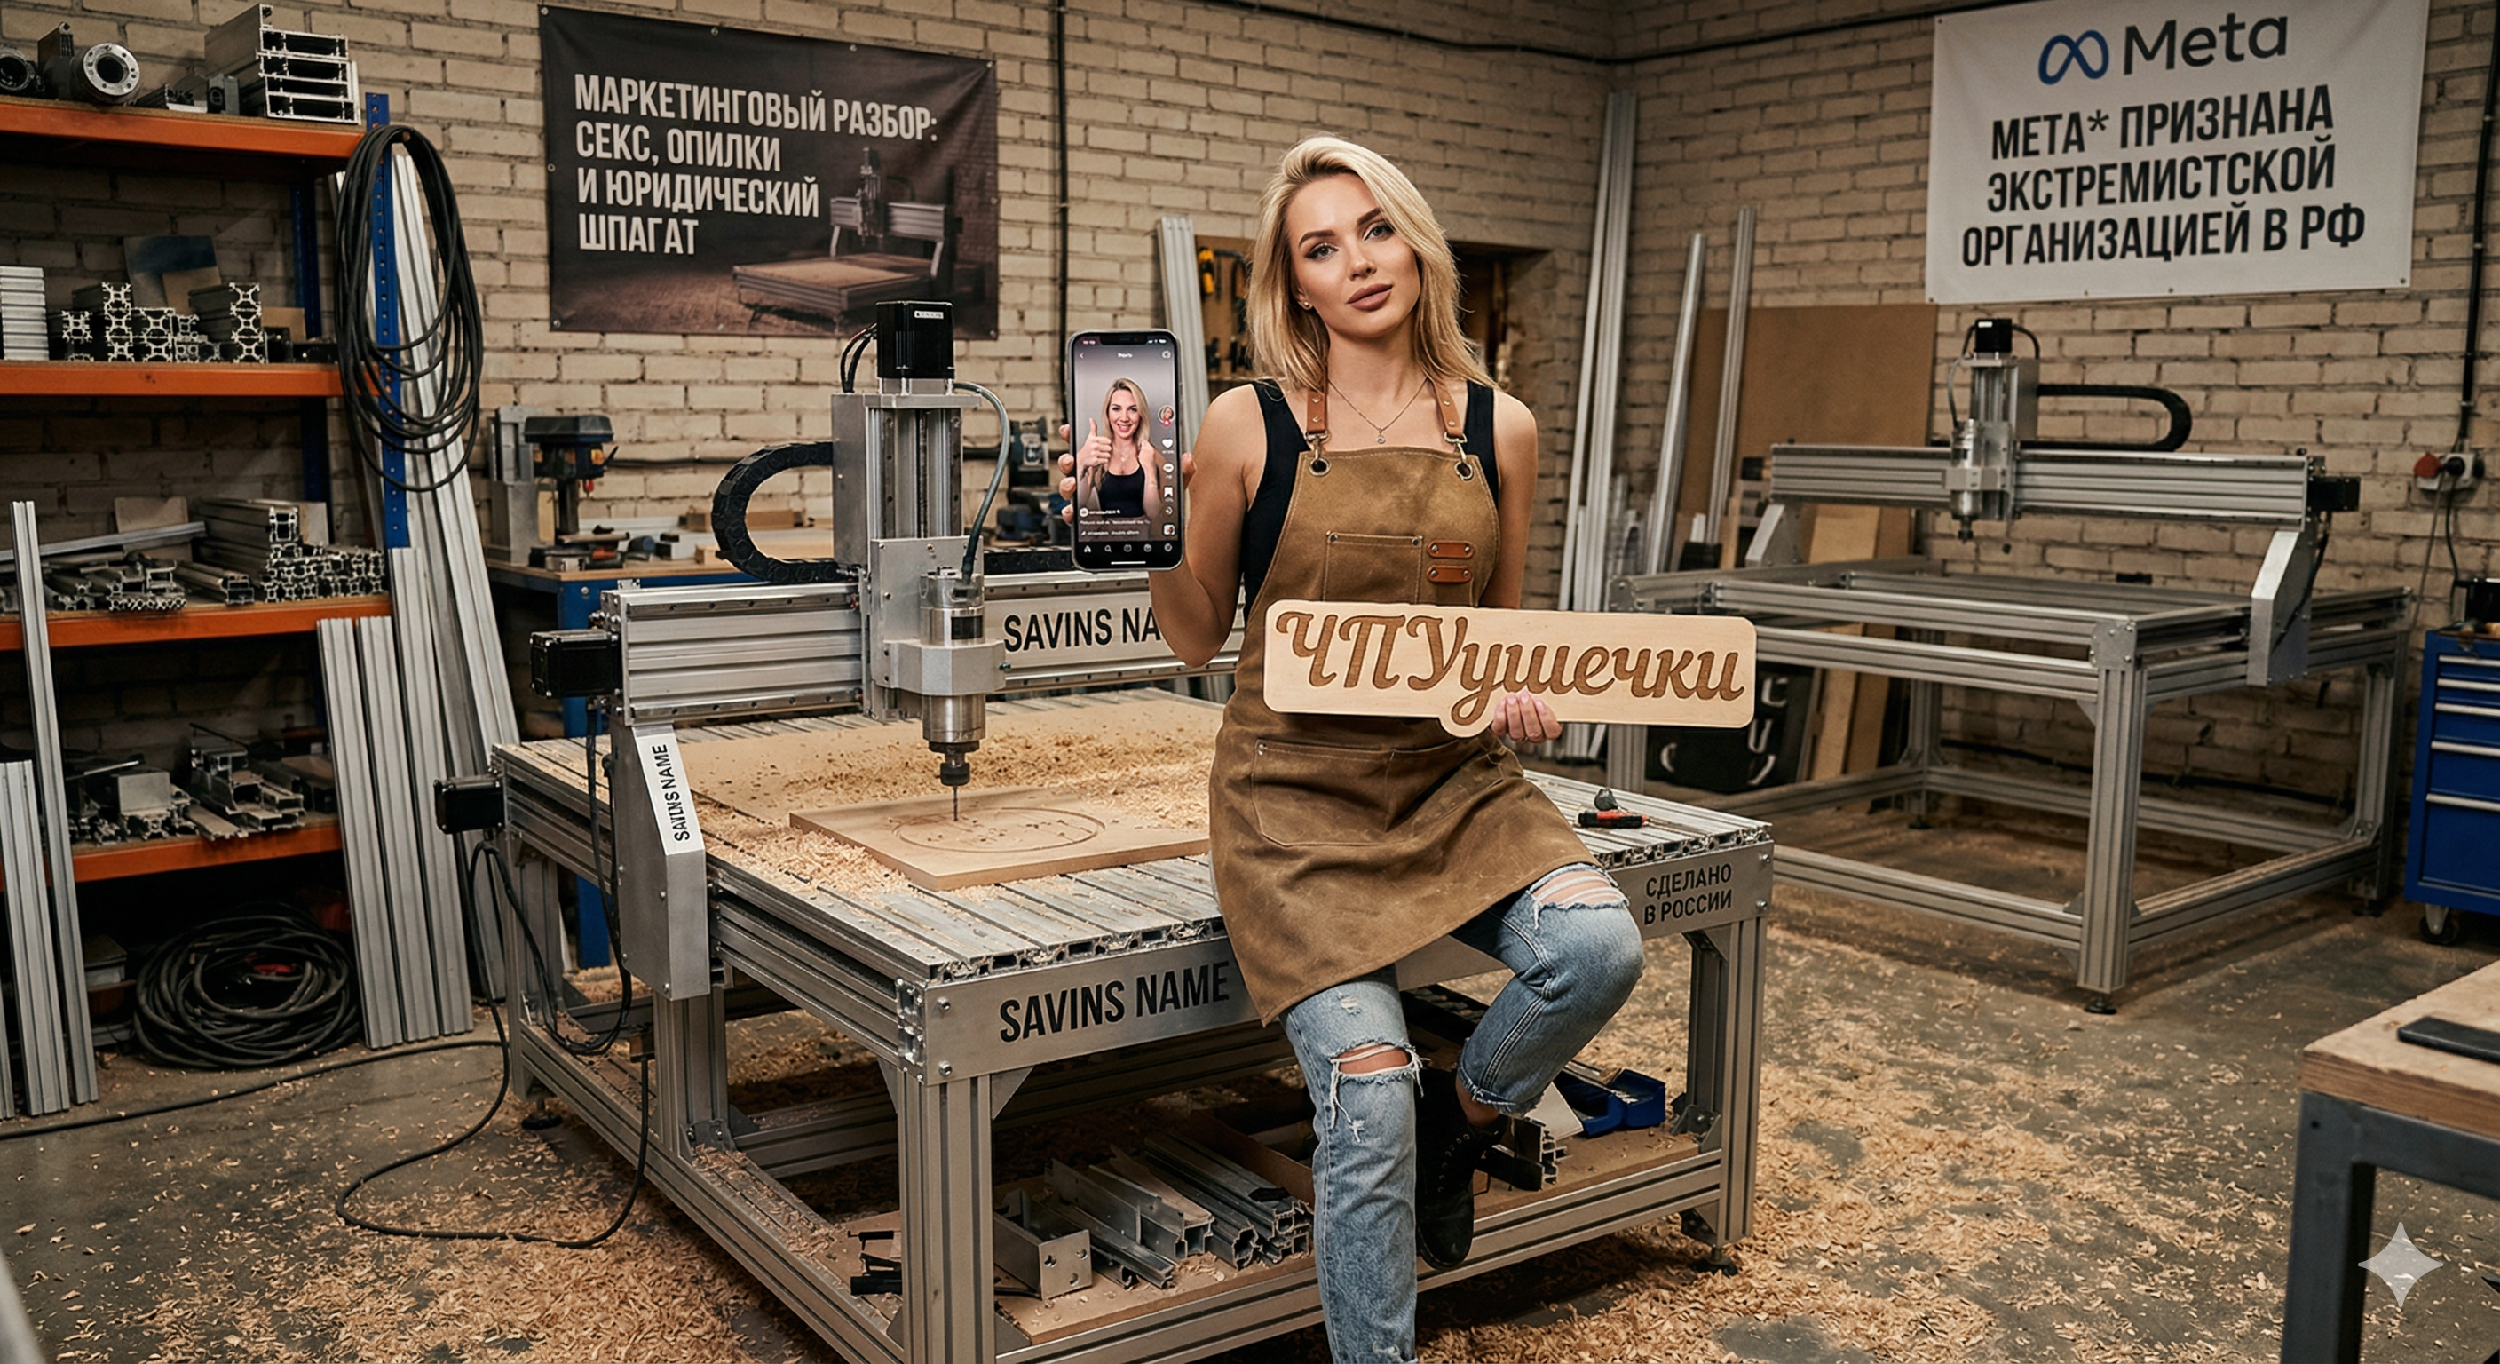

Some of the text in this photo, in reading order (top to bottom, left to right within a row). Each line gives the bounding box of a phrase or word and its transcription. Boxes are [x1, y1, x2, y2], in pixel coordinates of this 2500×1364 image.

[2123, 13, 2289, 75] Meta
[574, 73, 938, 142] МАРКЕТИНГОВЫЙ РАЗБОР:
[2120, 84, 2334, 149] ПРИЗНАНА
[576, 120, 781, 172] СЕКС, ОПИЛКИ
[1988, 134, 2337, 213] ЭКСТРЕМИСТСКОЙ
[578, 168, 820, 219] И ЮРИДИЧЕСКИЙ
[580, 214, 699, 256] ШПАГАТ
[1962, 201, 2365, 267] ОРГАНИЗАЦИЕЙ В РФ
[1004, 607, 1162, 653] SAVINS NA
[1276, 610, 1746, 727] ЧПУушечки
[652, 744, 676, 789] NAME
[1643, 889, 1733, 925] В РОССИИ
[1645, 863, 1732, 900] СДЕЛАНО
[1000, 960, 1230, 1043] SAVINS NAME
